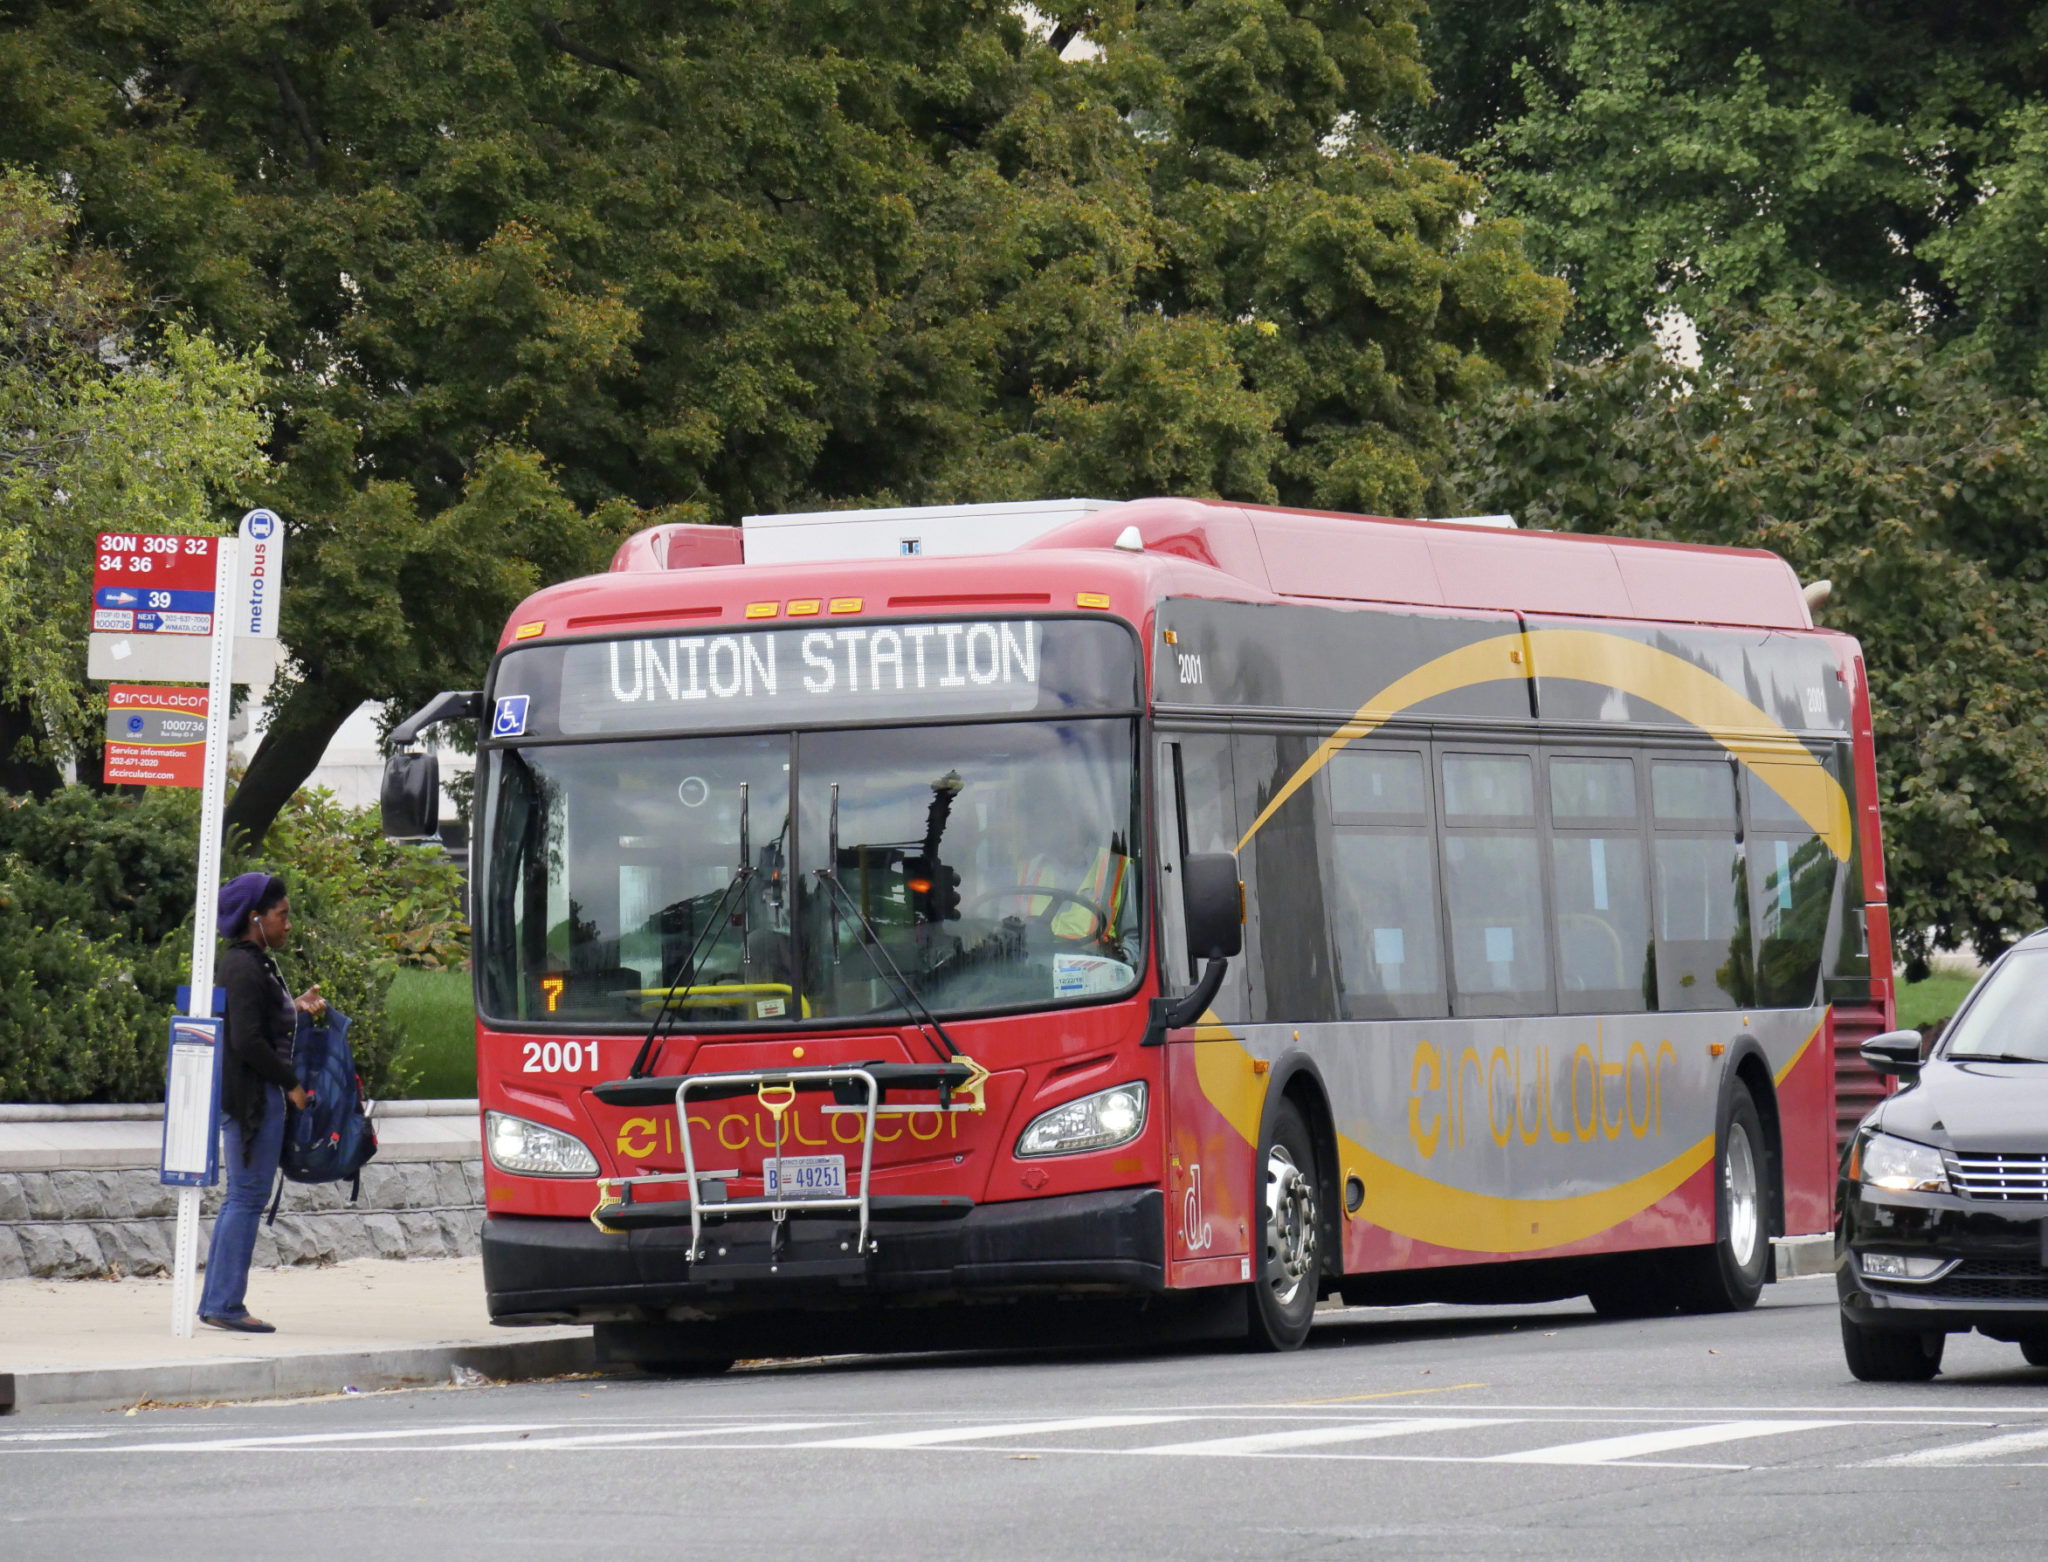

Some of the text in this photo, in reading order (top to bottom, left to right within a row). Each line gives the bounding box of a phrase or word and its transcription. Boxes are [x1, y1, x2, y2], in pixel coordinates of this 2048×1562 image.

[101, 536, 208, 555] 30N 30S 32
[99, 555, 152, 572] 34 36
[249, 543, 266, 633] metrobus
[148, 591, 171, 608] 39
[96, 619, 130, 628] 1000736
[137, 613, 156, 621] NEXT
[139, 622, 154, 630] BUS
[165, 624, 209, 632] WMATA.COM
[610, 620, 1035, 702] UNION STATION
[1178, 653, 1203, 684] 2001
[161, 720, 204, 731] 1000736
[110, 745, 186, 757] Service information:
[109, 757, 159, 767] 202-671-2020
[109, 768, 175, 779] dccirculator.com
[541, 978, 565, 1012] 7
[522, 1041, 599, 1073] 2001
[769, 1167, 840, 1189] B 49251
